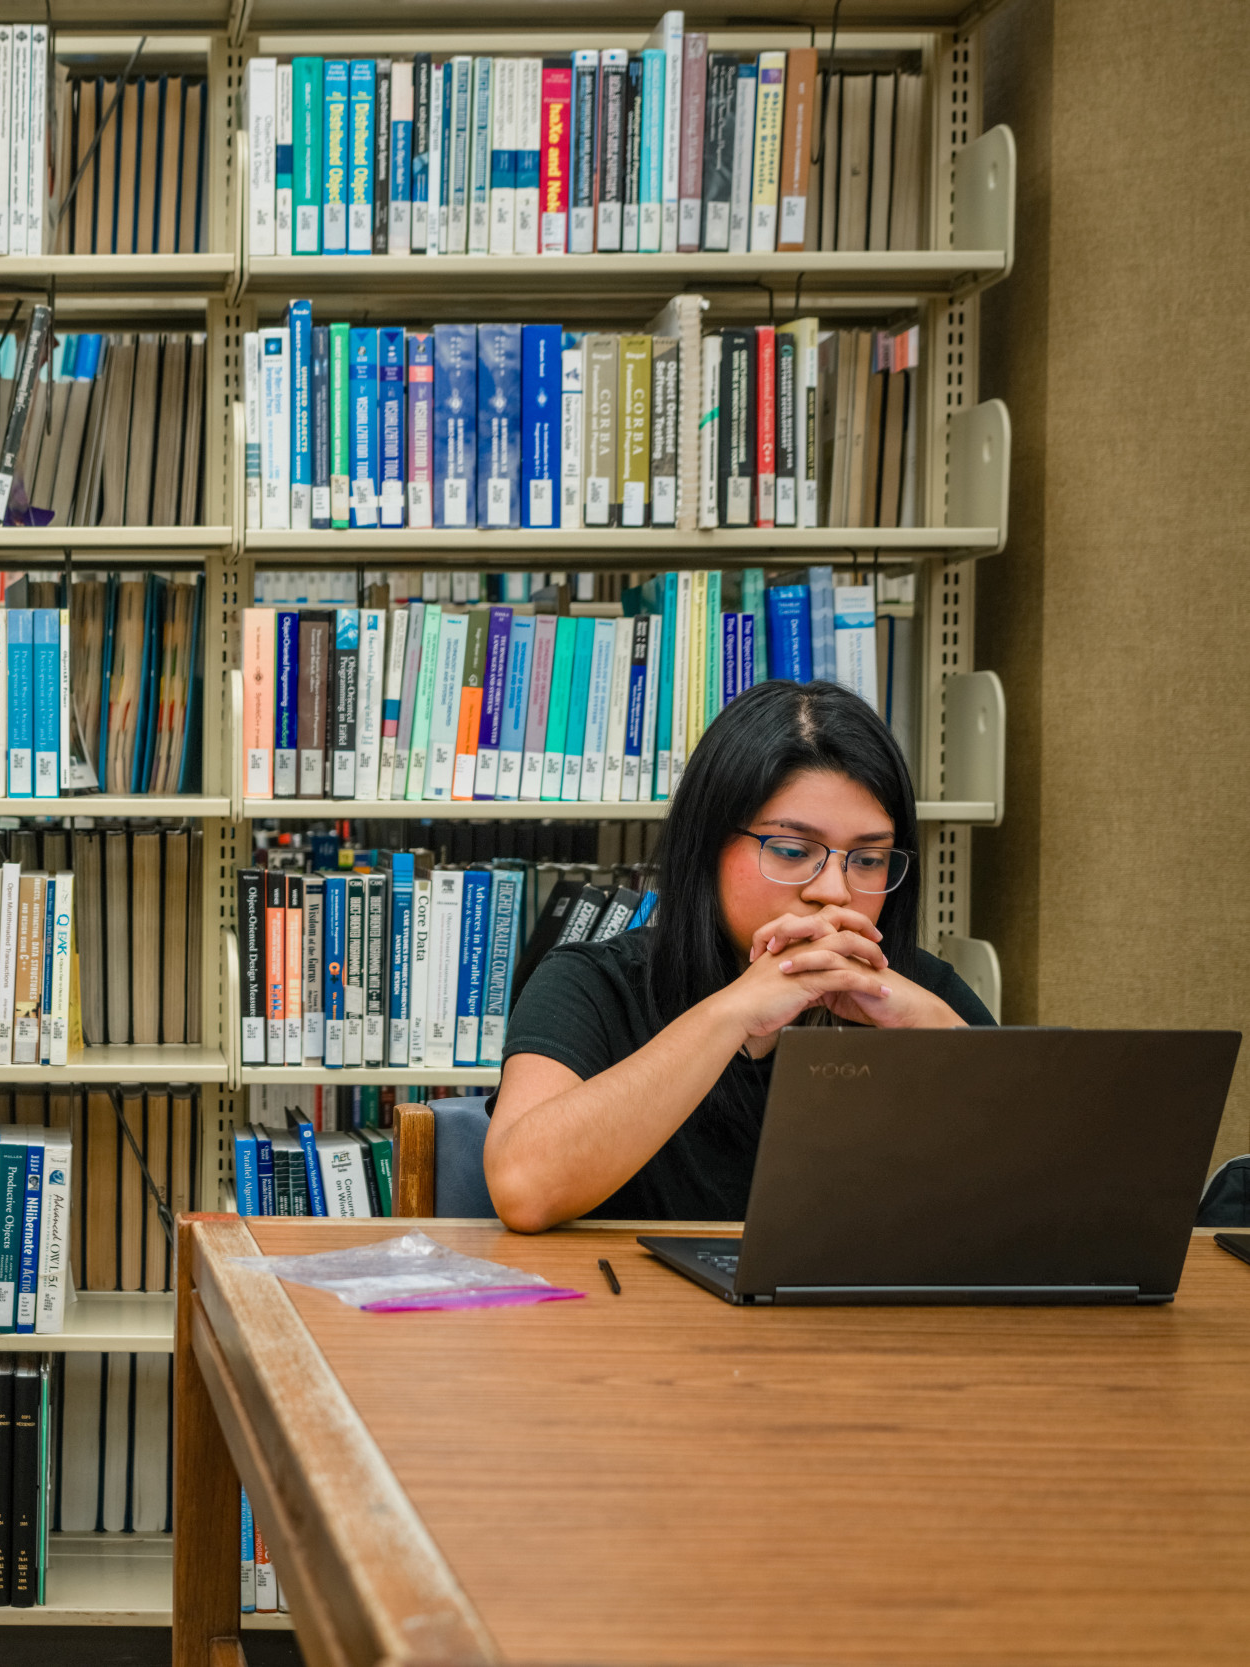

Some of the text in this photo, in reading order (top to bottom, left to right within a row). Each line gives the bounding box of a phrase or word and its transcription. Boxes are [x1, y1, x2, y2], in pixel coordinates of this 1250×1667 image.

[353, 103, 369, 166] Distributed
[547, 103, 563, 177] haXe and
[599, 389, 610, 457] CORBA
[632, 388, 644, 456] CORBA
[653, 361, 665, 459] Software Testing
[664, 361, 676, 453] Object Oriented
[337, 656, 348, 746] Programming in Eiffel
[346, 656, 355, 723] Object-Oriented
[3, 882, 14, 989] Open Multithreaded Transactions
[247, 886, 258, 982] Object-Oriented Design
[308, 903, 320, 937] Wisdom
[308, 945, 318, 956] the
[416, 895, 429, 962] Core Data
[470, 884, 485, 986] Advances in Parallel
[488, 882, 514, 1014] HIGHLY PARALLEL COMPUTING
[307, 957, 319, 983] Gurus
[809, 1063, 871, 1078] YOGA
[243, 1150, 253, 1179] Parallel
[2, 1166, 18, 1249] Productive Objects
[23, 1197, 39, 1266] NHibernate IN
[47, 1193, 65, 1273] Advanced OWL
